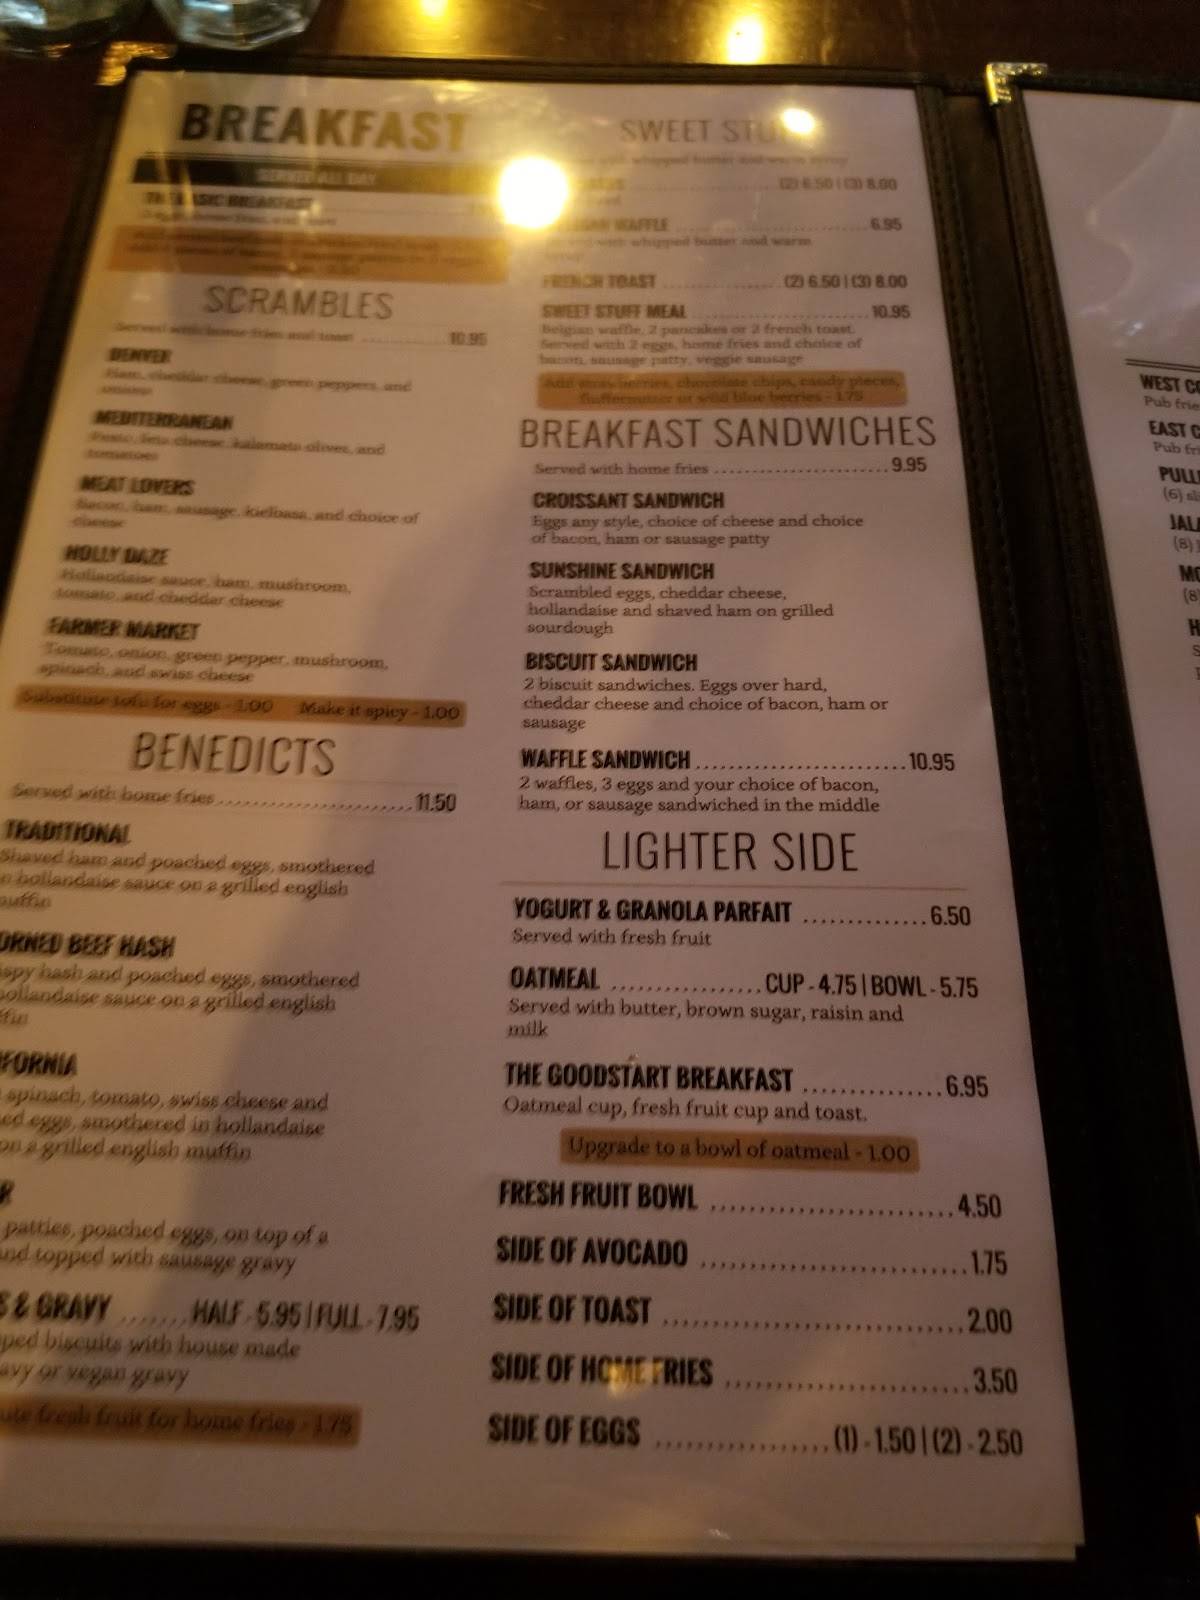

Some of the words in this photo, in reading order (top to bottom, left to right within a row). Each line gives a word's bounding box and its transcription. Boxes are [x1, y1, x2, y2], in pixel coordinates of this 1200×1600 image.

[180, 104, 471, 153] BREAKFAST
[621, 119, 711, 144] SWEET
[723, 119, 811, 146] STU
[615, 218, 669, 232] WAFFLE
[871, 219, 902, 231] 6.95
[543, 275, 602, 288] FRENCH
[608, 275, 656, 288] TOAST
[785, 276, 803, 288] (2)
[808, 276, 838, 287] 6.50
[853, 275, 871, 288] (3)
[876, 275, 907, 288] 8.00
[207, 285, 393, 320] SCRAMBLES
[541, 305, 590, 319] SWEET
[596, 305, 641, 319] STUFF
[647, 305, 686, 319] MEAL
[872, 306, 910, 319] 10.95
[109, 348, 171, 363] DENVER
[1140, 374, 1180, 393] WEST
[1145, 396, 1171, 408] Pub
[94, 410, 233, 430] MEDITERRANEAN
[1149, 420, 1186, 438] EAST
[520, 419, 701, 449] BREAKFAST
[716, 416, 936, 448] SANDWICHES
[1154, 441, 1180, 454] Pub
[535, 463, 585, 475] Served
[590, 464, 623, 475] with
[628, 464, 670, 475] home
[675, 463, 708, 475] fries
[892, 457, 927, 473] 9.95
[80, 476, 127, 494] MEAT
[131, 477, 195, 496] LOVERS
[1164, 488, 1183, 503] (6)
[533, 492, 628, 509] CROISSANT
[634, 492, 724, 509] SANDWICH
[1174, 535, 1193, 552] (8)
[64, 545, 121, 565] HOLLY
[124, 547, 168, 566] DAZE
[530, 562, 617, 579] SUNSHINE
[622, 563, 714, 580] SANDWICH
[48, 618, 122, 638] FARMER
[126, 620, 200, 641] MARKET
[526, 653, 598, 670] BISCUIT
[602, 653, 697, 671] SANDWICH
[524, 679, 534, 691] 2
[539, 678, 593, 691] biscuit
[598, 678, 695, 692] sandwiches.
[700, 679, 738, 695] Eggs
[743, 681, 779, 692] over
[783, 678, 827, 694] hard,
[301, 703, 344, 717] Make
[349, 704, 361, 717] it
[366, 705, 407, 721] spicy
[424, 707, 459, 720] 1.00
[131, 732, 336, 776] BENEDICTS
[522, 749, 587, 768] WAFFLE
[592, 750, 690, 770] SANDWICH
[910, 752, 954, 772] 10.95
[13, 783, 72, 799] Served
[78, 786, 116, 801] with
[122, 789, 171, 803] home
[175, 789, 214, 805] fries
[416, 793, 456, 812] 11.50
[519, 778, 530, 790] 2
[534, 777, 598, 792] waffles,
[602, 778, 612, 791] 3
[617, 781, 654, 795] eggs
[658, 778, 689, 792] and
[694, 781, 735, 796] your
[740, 778, 795, 792] choice
[800, 778, 818, 792] of
[821, 778, 879, 795] bacon,
[519, 796, 560, 813] ham,
[564, 801, 583, 812] or
[588, 800, 654, 816] sausage
[659, 798, 759, 813] sandwiched
[764, 798, 781, 813] in
[785, 798, 814, 813] the
[819, 798, 880, 813] middle
[6, 820, 130, 844] TRADITIONAL
[603, 832, 756, 871] LIGHTER
[774, 833, 858, 872] SIDE
[513, 898, 593, 920] YOGURT
[597, 899, 610, 920] &
[616, 900, 706, 922] GRANOLA
[715, 901, 792, 923] PARFAIT
[931, 906, 971, 926] 6.50
[68, 933, 113, 956] BEEF
[119, 935, 175, 959] HASH
[512, 928, 572, 944] Served
[577, 928, 616, 945] with
[621, 929, 667, 945] fresh
[672, 929, 712, 946] fruit
[511, 967, 599, 990] OATMEAL
[766, 973, 804, 994] CUP
[819, 974, 857, 995] 4.75
[872, 975, 928, 997] BOWL
[940, 977, 978, 998] 5.75
[509, 999, 570, 1015] Served
[575, 999, 614, 1016] with
[619, 1000, 681, 1019] butter,
[687, 1003, 744, 1019] brown
[750, 1008, 806, 1024] sugar,
[811, 1006, 864, 1021] raisin
[869, 1007, 903, 1022] and
[507, 1022, 548, 1038] milk
[505, 1063, 542, 1087] THE
[548, 1064, 671, 1089] GOODSTART
[677, 1066, 793, 1093] BREAKFAST
[946, 1075, 988, 1098] 6.95
[504, 1097, 582, 1115] Oatmeal
[588, 1102, 628, 1120] cup,
[632, 1099, 681, 1117] fresh
[686, 1100, 728, 1119] fruit
[734, 1105, 770, 1124] cup
[774, 1103, 809, 1121] and
[816, 1104, 867, 1122] toast.
[568, 1137, 650, 1159] Upgrade
[656, 1140, 675, 1156] to
[680, 1146, 692, 1157] a
[697, 1140, 741, 1158] bowl
[746, 1141, 767, 1158] of
[772, 1142, 849, 1160] oatmeal
[869, 1144, 911, 1161] 1.00
[498, 1180, 564, 1206] FRESH
[571, 1182, 631, 1208] FRUIT
[638, 1184, 697, 1210] BOWL
[958, 1195, 1001, 1218] 4.50
[496, 1237, 543, 1263] SIDE
[550, 1238, 576, 1264] OF
[583, 1239, 688, 1267] AVOCADO
[971, 1251, 1007, 1275] 1.75
[13, 1291, 30, 1318] &
[37, 1292, 111, 1321] GRAVY
[192, 1300, 244, 1324] HALF
[258, 1301, 301, 1328] 5.95
[317, 1304, 363, 1329] FULL
[377, 1304, 419, 1331] 7.95
[494, 1294, 542, 1322] SIDE
[549, 1295, 576, 1323] OF
[582, 1297, 651, 1325] TOAST
[968, 1308, 1012, 1334] 2.00
[491, 1354, 540, 1381] SIDE
[547, 1355, 576, 1383] OF
[581, 1356, 646, 1384] HOME
[652, 1358, 713, 1386] FRIES
[974, 1368, 1017, 1394] 3.50
[488, 1414, 538, 1443] SIDE
[545, 1416, 574, 1445] OF
[580, 1417, 640, 1446] EGGS
[834, 1425, 859, 1453] (1)
[876, 1427, 916, 1454] 1.50
[933, 1428, 962, 1456] (2)
[978, 1430, 1023, 1456] 2.50
